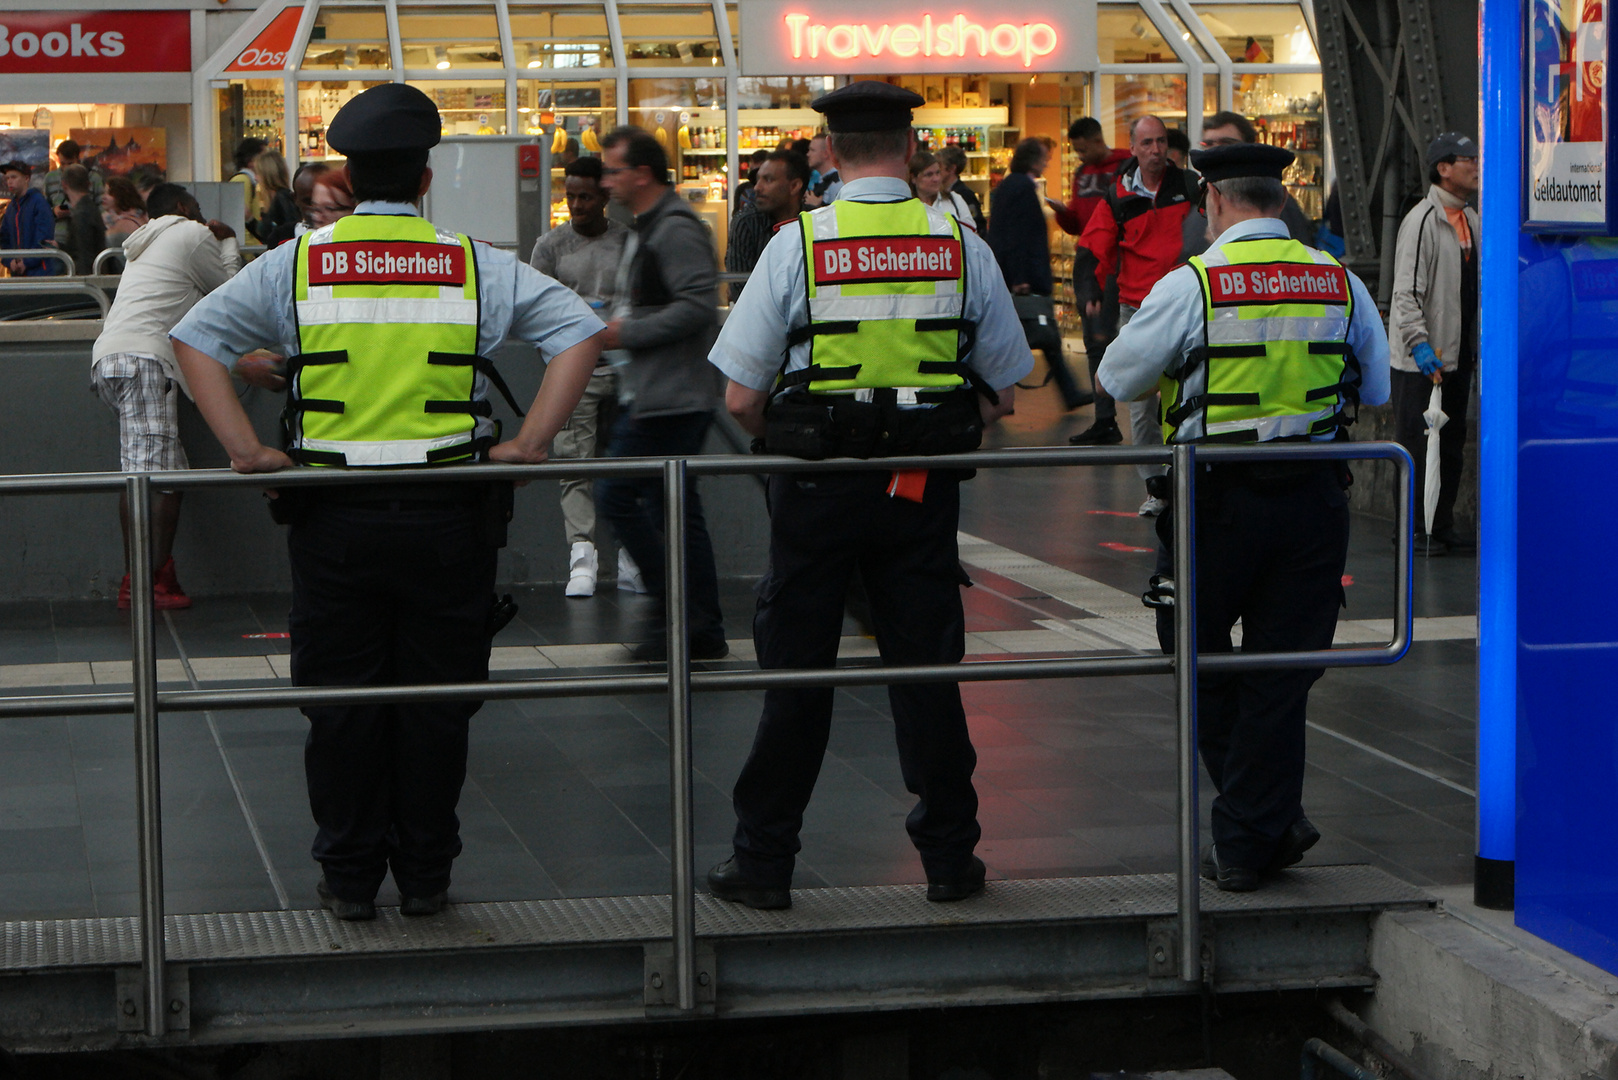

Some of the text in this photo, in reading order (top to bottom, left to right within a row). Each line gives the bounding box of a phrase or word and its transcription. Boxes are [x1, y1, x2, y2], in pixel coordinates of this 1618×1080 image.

[784, 13, 1057, 67] Travelshop
[1569, 162, 1602, 174] international
[1533, 176, 1602, 203] Geldautomat
[321, 250, 453, 275] DB Sicherheit
[821, 246, 953, 275] DB Sicherheit
[1219, 270, 1340, 295] DB Sicherheit
